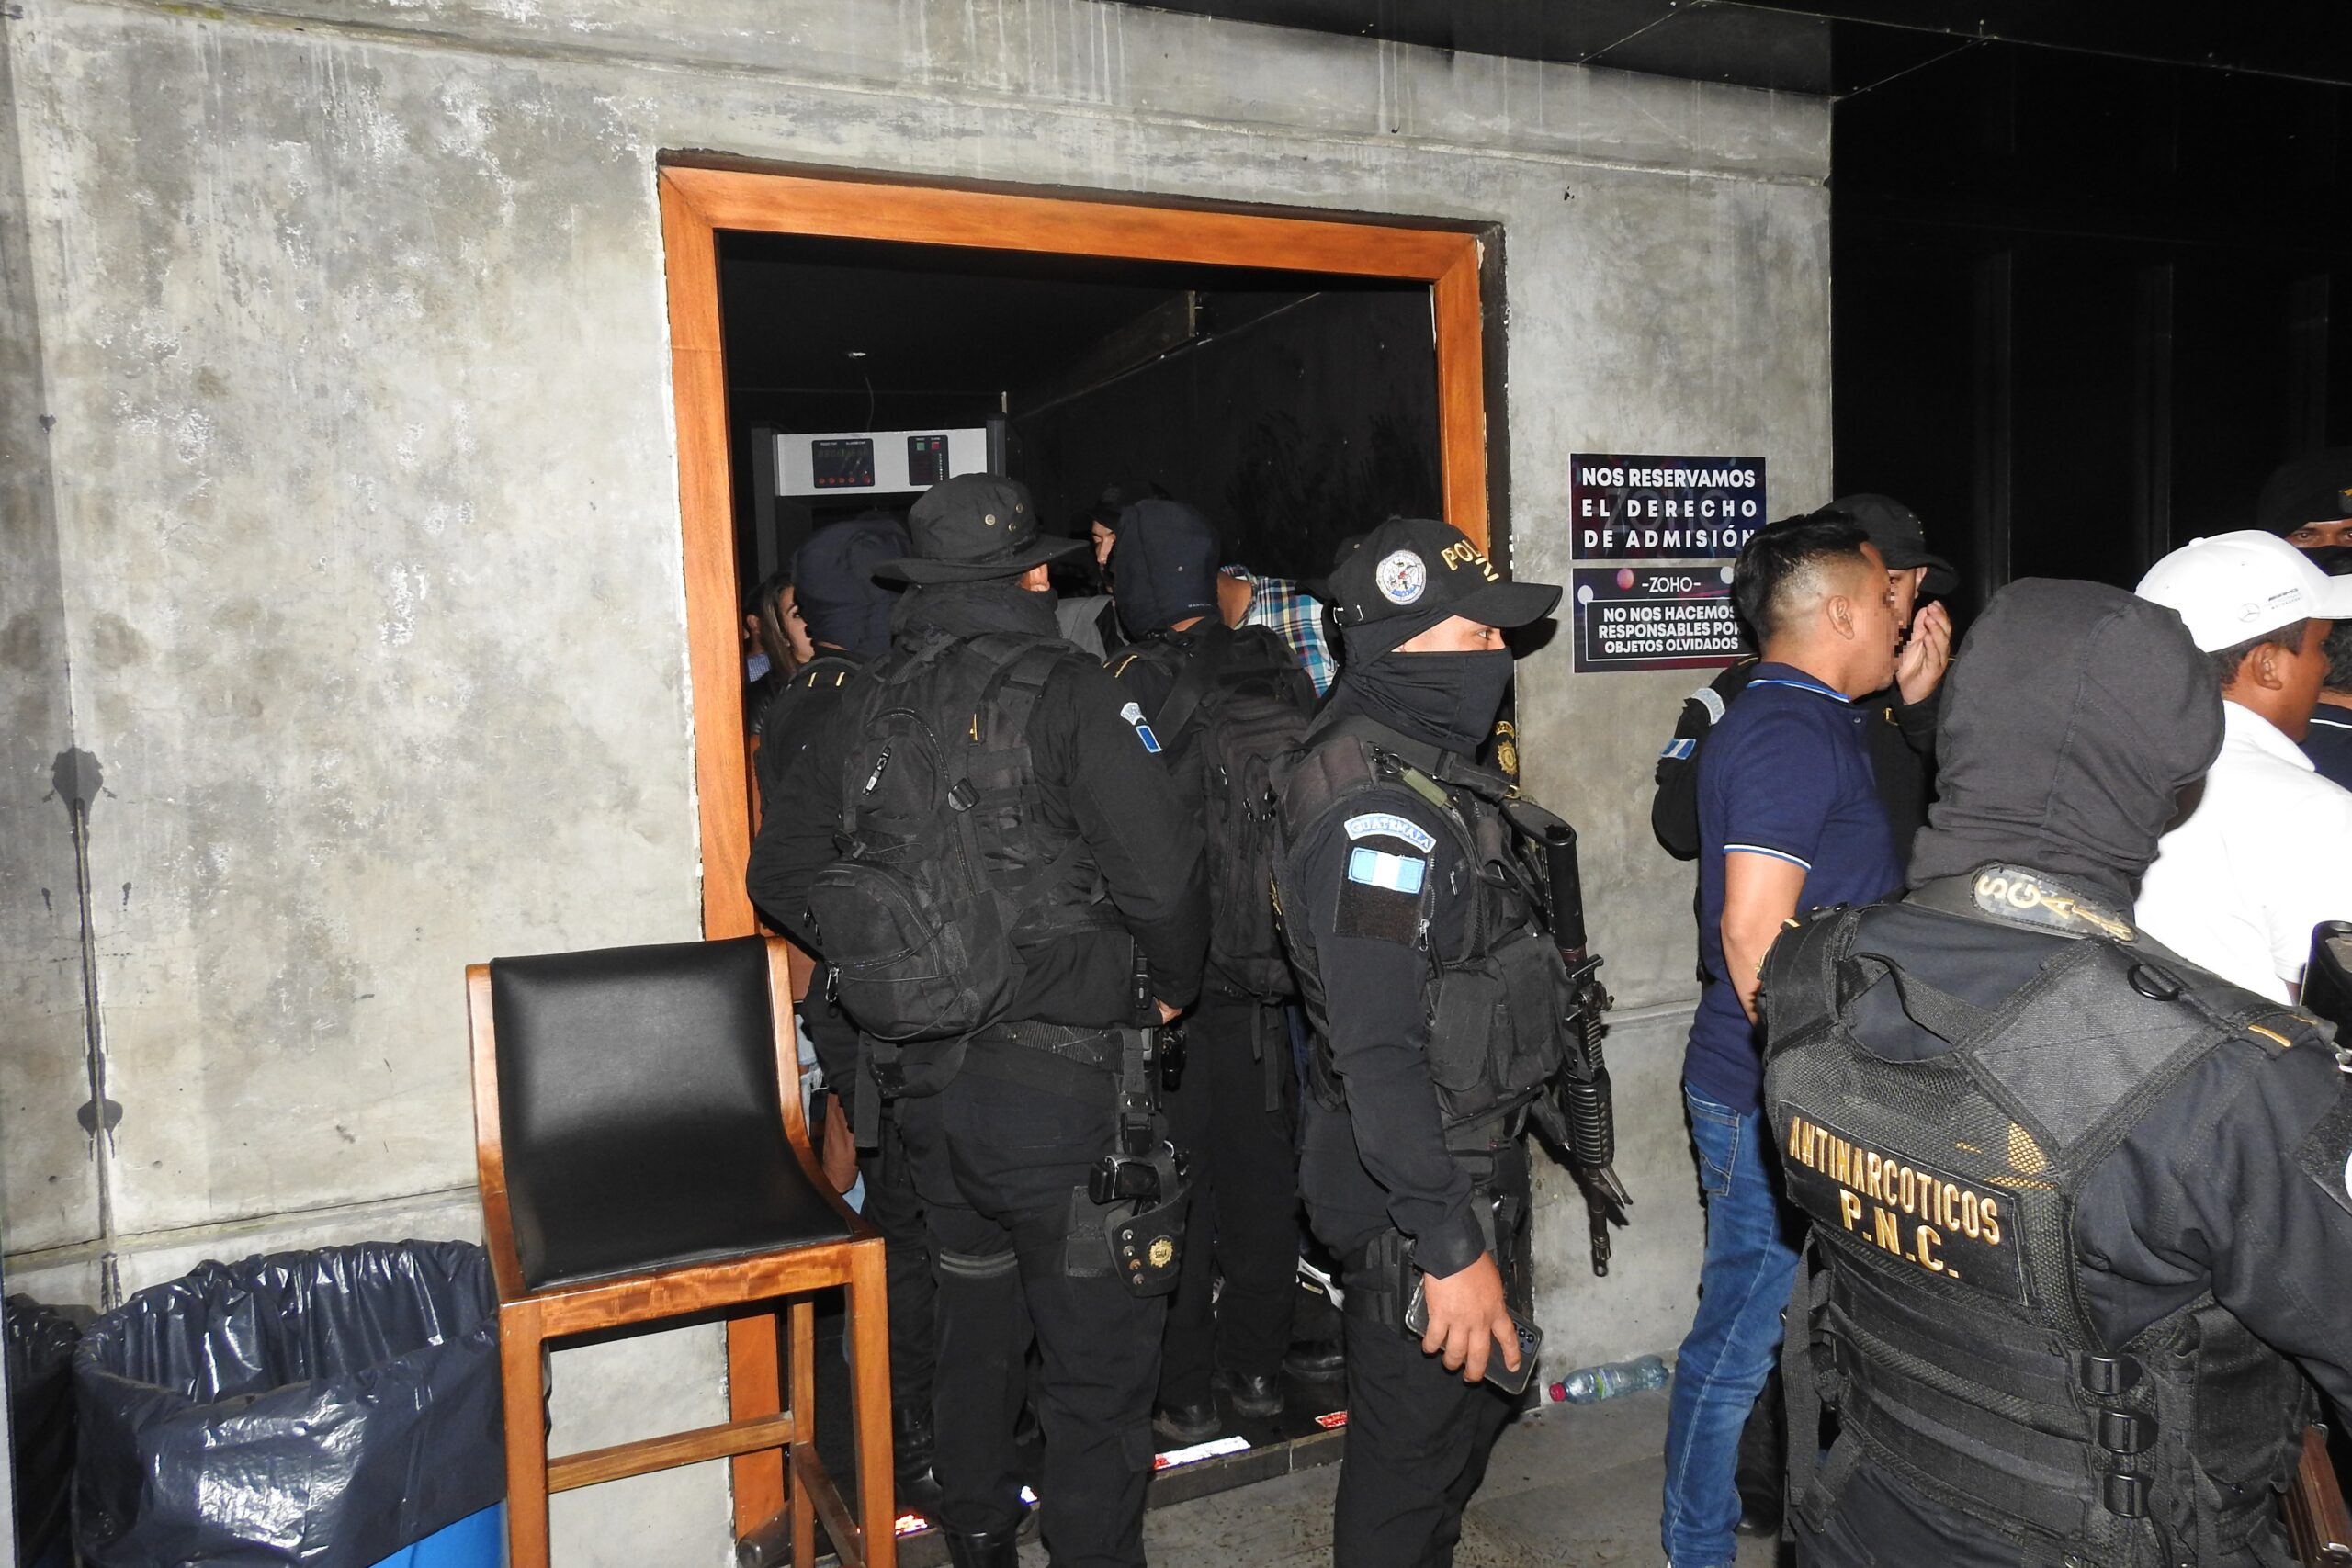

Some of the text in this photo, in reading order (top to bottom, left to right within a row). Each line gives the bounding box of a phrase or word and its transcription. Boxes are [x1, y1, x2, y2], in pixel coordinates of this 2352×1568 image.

[1582, 468, 1756, 488] NOS RESERVAMOS
[1582, 499, 1757, 518] EL DERECHO
[1584, 530, 1613, 548] DE
[1603, 607, 1627, 622] NO
[1630, 606, 1662, 622] NOS
[1599, 622, 1711, 639] RESPONSABLES
[1604, 637, 1738, 654] OBJETOS OLVIDADOS
[1351, 816, 1430, 849] GUATEMALA
[1789, 1116, 2001, 1246] ANTINARCOTICOS
[1839, 1189, 1960, 1279] P.N.C.
